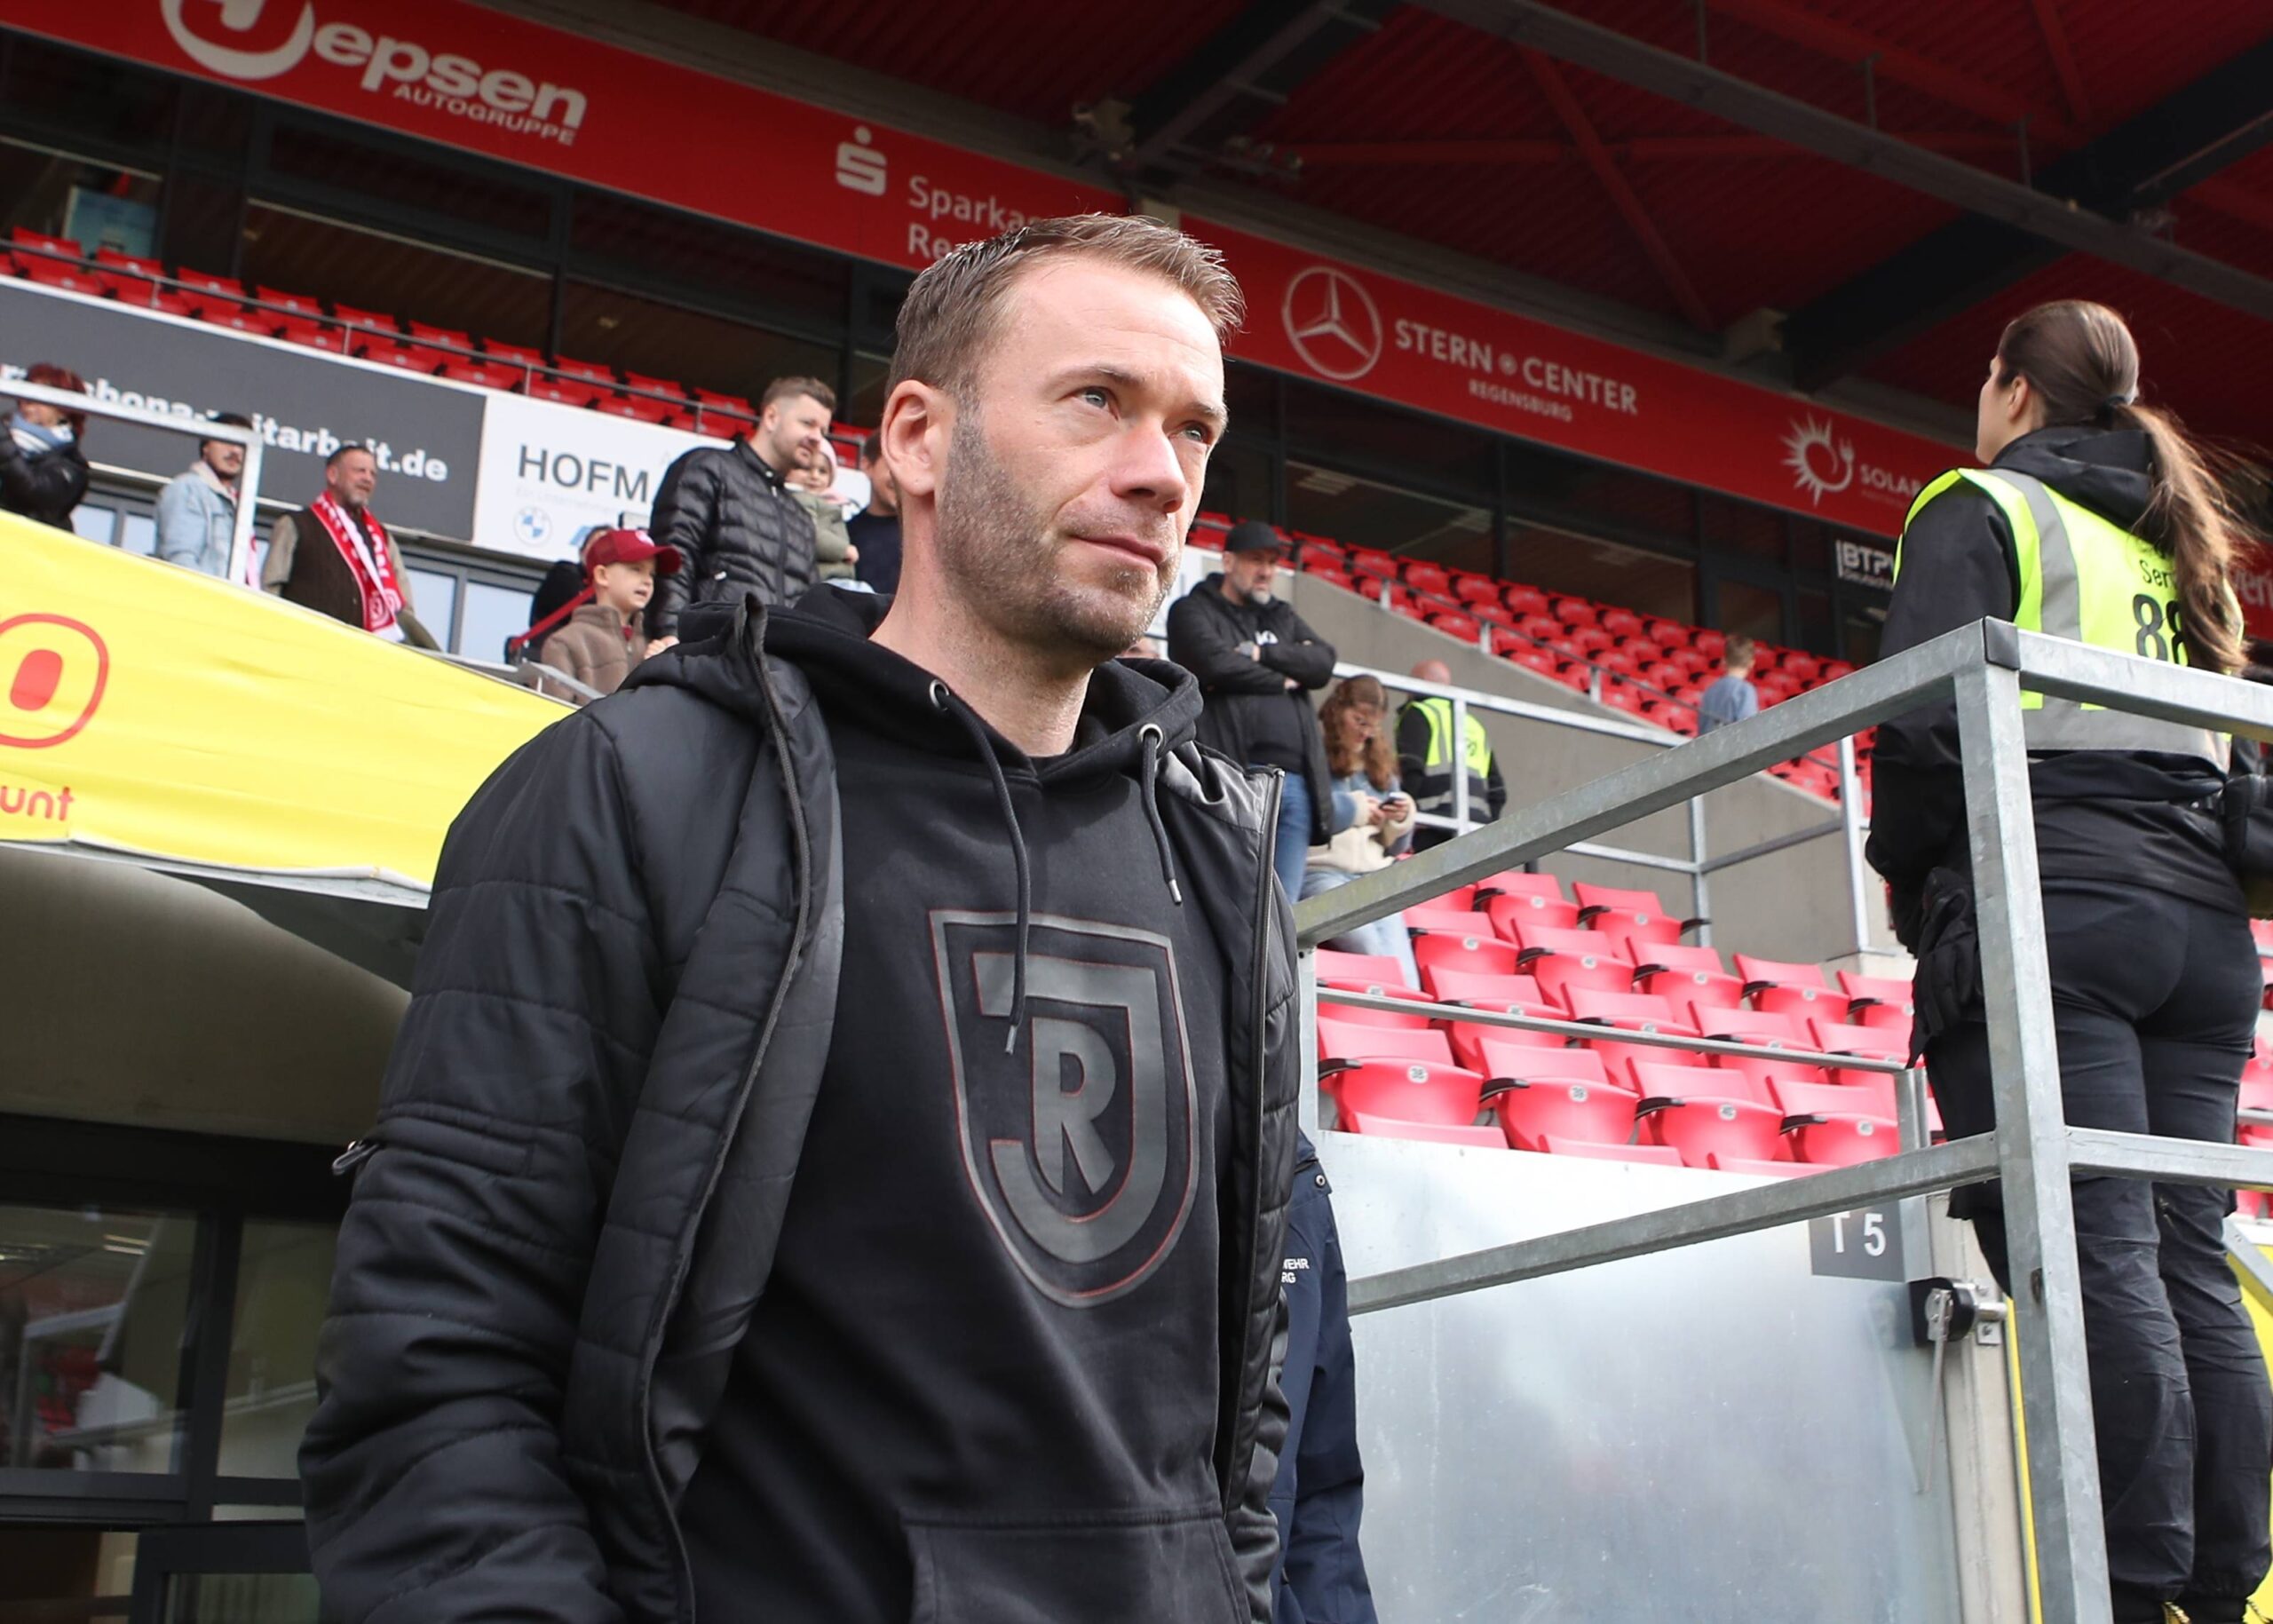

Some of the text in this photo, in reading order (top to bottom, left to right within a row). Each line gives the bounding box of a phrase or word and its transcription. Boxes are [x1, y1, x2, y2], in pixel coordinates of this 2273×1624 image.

[393, 83, 575, 146] AUTOGRUPPE
[1395, 318, 1639, 415] STERN CENTER
[1469, 379, 1572, 423] REGENSBURG
[518, 444, 649, 503] HOFM
[1864, 1213, 1887, 1257] 5
